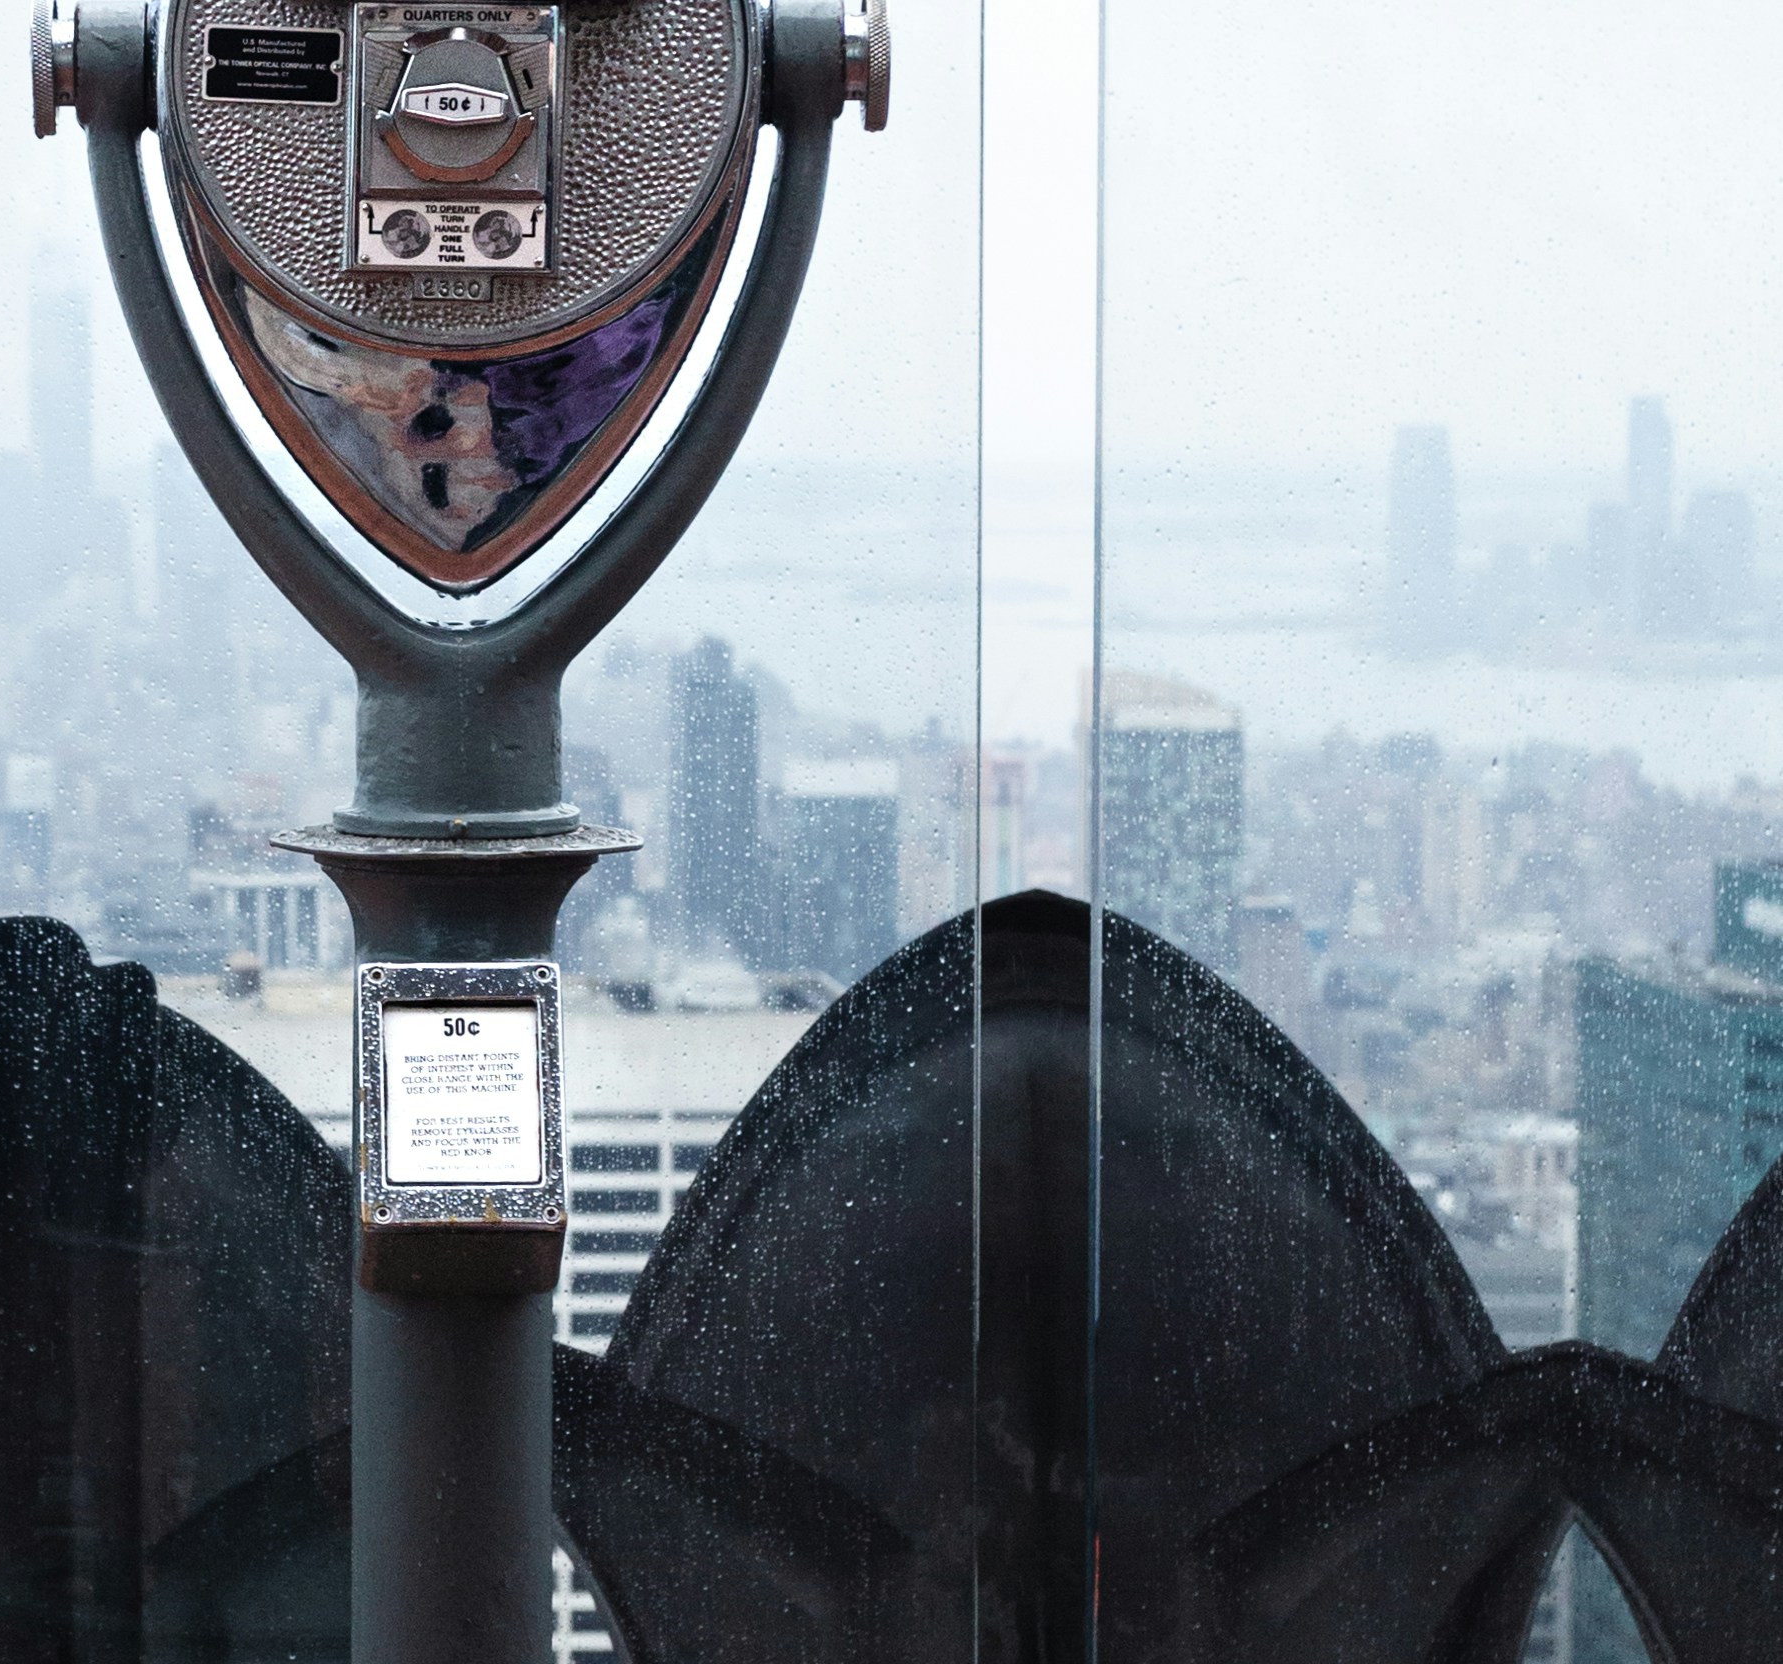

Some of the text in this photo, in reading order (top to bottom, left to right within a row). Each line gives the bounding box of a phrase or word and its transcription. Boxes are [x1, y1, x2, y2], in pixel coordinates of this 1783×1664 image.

[403, 9, 512, 22] QUARTERS ONLY
[258, 39, 306, 48] Manufactured
[257, 47, 295, 55] Distributed
[218, 58, 229, 66] THE
[231, 59, 253, 67] TOWER
[253, 60, 279, 68] OPTICAL
[425, 204, 481, 214] TO OPERATE
[440, 214, 465, 223] TURN
[434, 224, 470, 234] HANDLE
[441, 234, 463, 244] ONE
[439, 244, 465, 254] FULL
[437, 254, 465, 263] TURN
[443, 1017, 481, 1037] 50¢
[404, 1052, 521, 1064] BRING DISTANT POINTS
[411, 1062, 515, 1074] OF INTEREST WITHIN
[401, 1072, 525, 1085] CLOSE RANGE WITH THE
[406, 1086, 425, 1095] USE
[428, 1086, 441, 1094] OF
[446, 1085, 468, 1094] THIS
[416, 1116, 511, 1126] FOR BEST RESULTS
[411, 1126, 520, 1137] REMOVE EYEGLASSES
[411, 1136, 522, 1148] AND FOCUS WITH THE
[441, 1148, 493, 1157] RED KNOB
